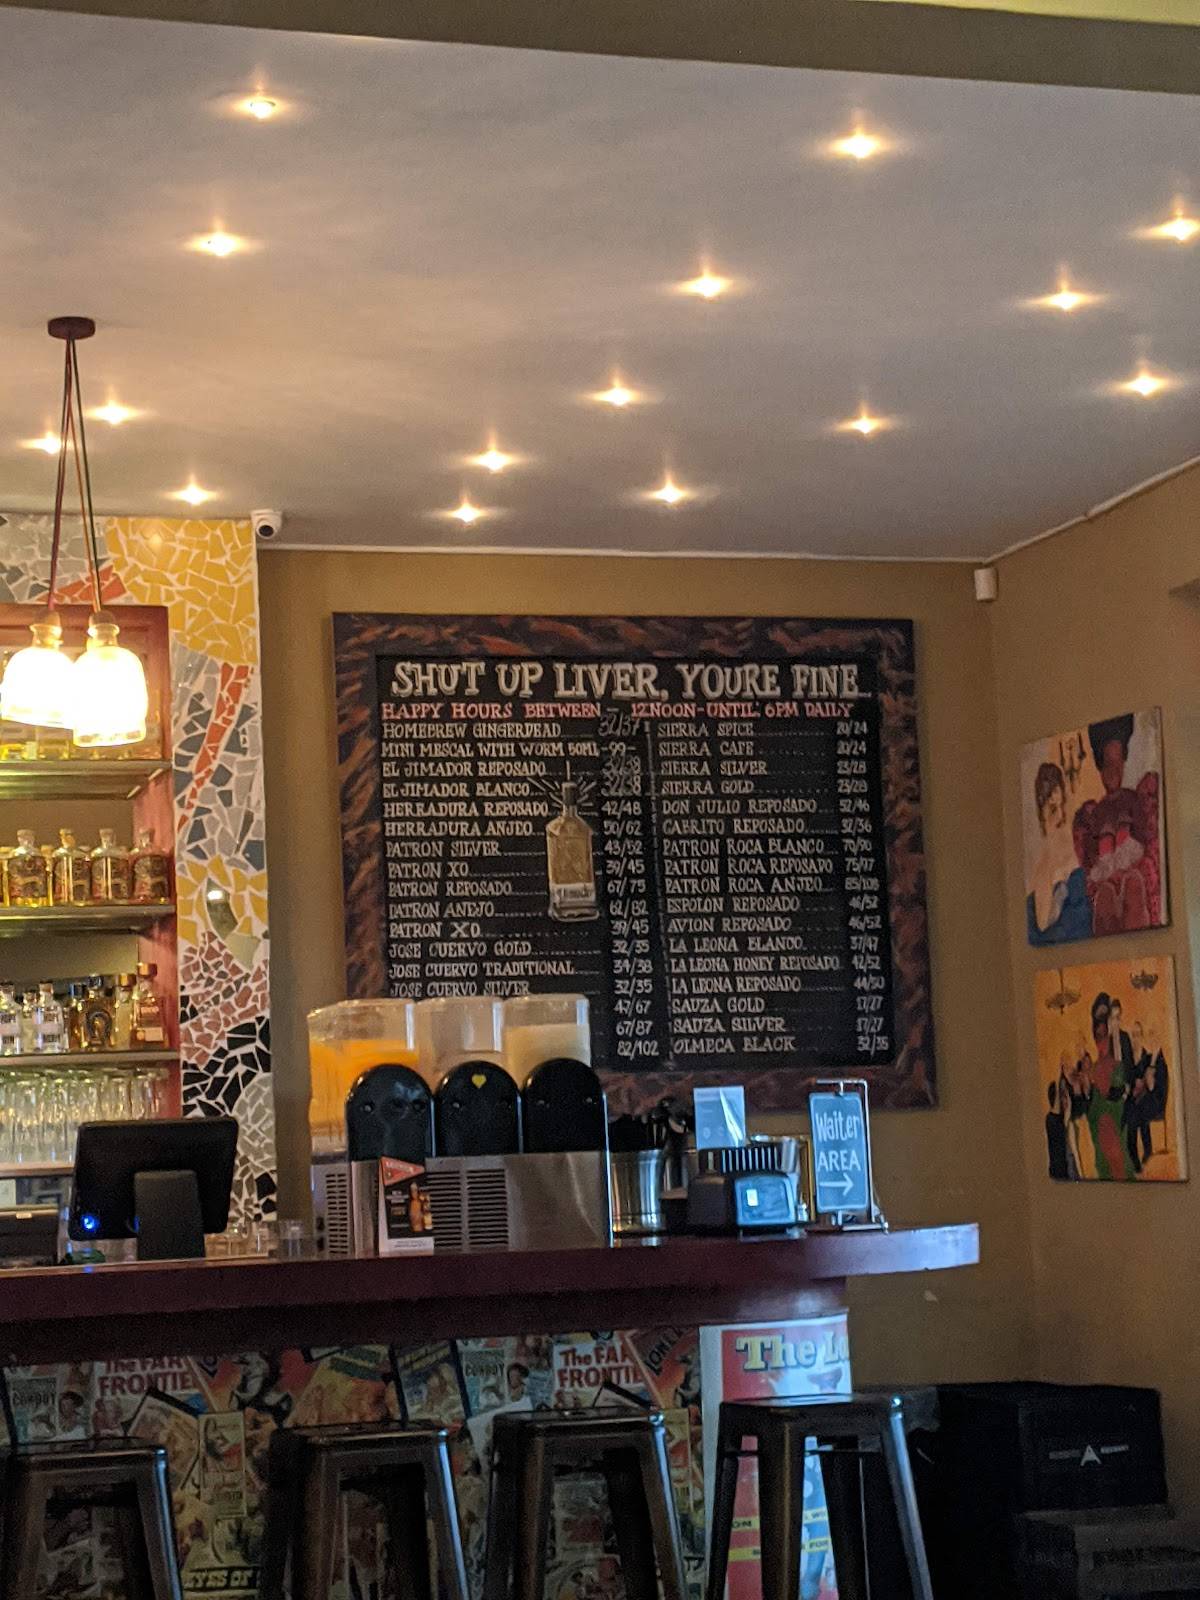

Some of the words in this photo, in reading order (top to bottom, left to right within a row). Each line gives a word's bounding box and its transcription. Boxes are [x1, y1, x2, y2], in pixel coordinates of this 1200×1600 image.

[392, 661, 486, 697] SHUT
[495, 662, 544, 698] UP
[552, 662, 669, 701] LIVER,
[676, 664, 781, 698] YOURE
[382, 703, 443, 720] HAPPY
[451, 703, 513, 718] HOURS
[523, 703, 600, 718] BETWEEN
[765, 703, 799, 718] 6PM
[804, 703, 854, 718] DAILY
[657, 722, 709, 737] SIERRA
[717, 722, 754, 736] SPICE
[381, 742, 414, 758] MINI
[419, 742, 474, 758] MESCAL
[477, 742, 516, 757] WITH
[518, 742, 564, 756] WORM
[659, 742, 712, 757] SIERRA
[720, 742, 754, 756] CAFE
[383, 762, 400, 776] EL
[404, 761, 473, 776] JIMADOR
[478, 761, 546, 776] REPOSADO
[661, 761, 711, 776] SIERRA
[720, 761, 768, 776] SILVER
[383, 783, 398, 798] EL
[401, 783, 470, 797] JIMADOR
[475, 782, 530, 797] BLANCO
[661, 780, 714, 795] SIERRA
[720, 780, 754, 794] GOLD
[383, 802, 478, 818] HERRADURA
[484, 802, 549, 817] REPOSADO
[662, 801, 690, 814] DON
[697, 800, 741, 814] JULIO
[748, 799, 817, 814] REPOSADO
[385, 822, 481, 836] HERRADURA
[663, 820, 725, 835] CABRITO
[733, 818, 805, 833] REPOSADO
[386, 842, 444, 857] PATRON
[451, 841, 501, 856] SILVER
[663, 839, 720, 856] PATRON
[726, 838, 761, 854] ROCA
[768, 838, 824, 855] BLANCO
[388, 863, 442, 878] PATRON
[448, 862, 469, 877] XO
[664, 859, 719, 875] PATRON
[727, 858, 766, 874] ROCA
[388, 882, 439, 897] PATRON
[445, 882, 512, 896] REPOSADO
[665, 878, 720, 893] PATRON
[728, 877, 764, 892] ROCA
[389, 903, 440, 920] PATRON
[443, 902, 494, 917] ANEJO
[666, 898, 724, 913] ESPOLON
[733, 897, 800, 912] REPOSADO
[389, 923, 442, 938] PATRON
[451, 922, 481, 938] XO
[668, 918, 714, 933] AVION
[722, 917, 792, 932] REPOSADO
[389, 943, 421, 959] JOSE
[429, 942, 487, 958] CUERVO
[494, 942, 532, 956] GOLD
[669, 938, 688, 952] LA
[694, 937, 739, 952] LEONA
[747, 936, 803, 951] BLANCO
[389, 964, 420, 979] JOSE
[425, 963, 478, 978] CUERVO
[483, 961, 575, 976] TRADITIONAL
[671, 959, 689, 972] LA
[689, 958, 730, 972] LEONA
[734, 957, 776, 972] HONEY
[391, 983, 422, 997] JOSE
[427, 982, 478, 997] CUERVO
[483, 981, 529, 996] SILVER
[672, 979, 689, 994] LA
[692, 978, 732, 993] LEONA
[737, 976, 801, 993] REPOSADO
[727, 997, 765, 1013] GOLD
[731, 1017, 786, 1032] SILVER
[673, 1038, 735, 1054] OLMECA
[743, 1036, 796, 1051] BLACK
[816, 1111, 859, 1142] Waiter
[817, 1150, 861, 1172] AREA
[559, 1348, 592, 1367] The
[736, 1334, 817, 1370] The
